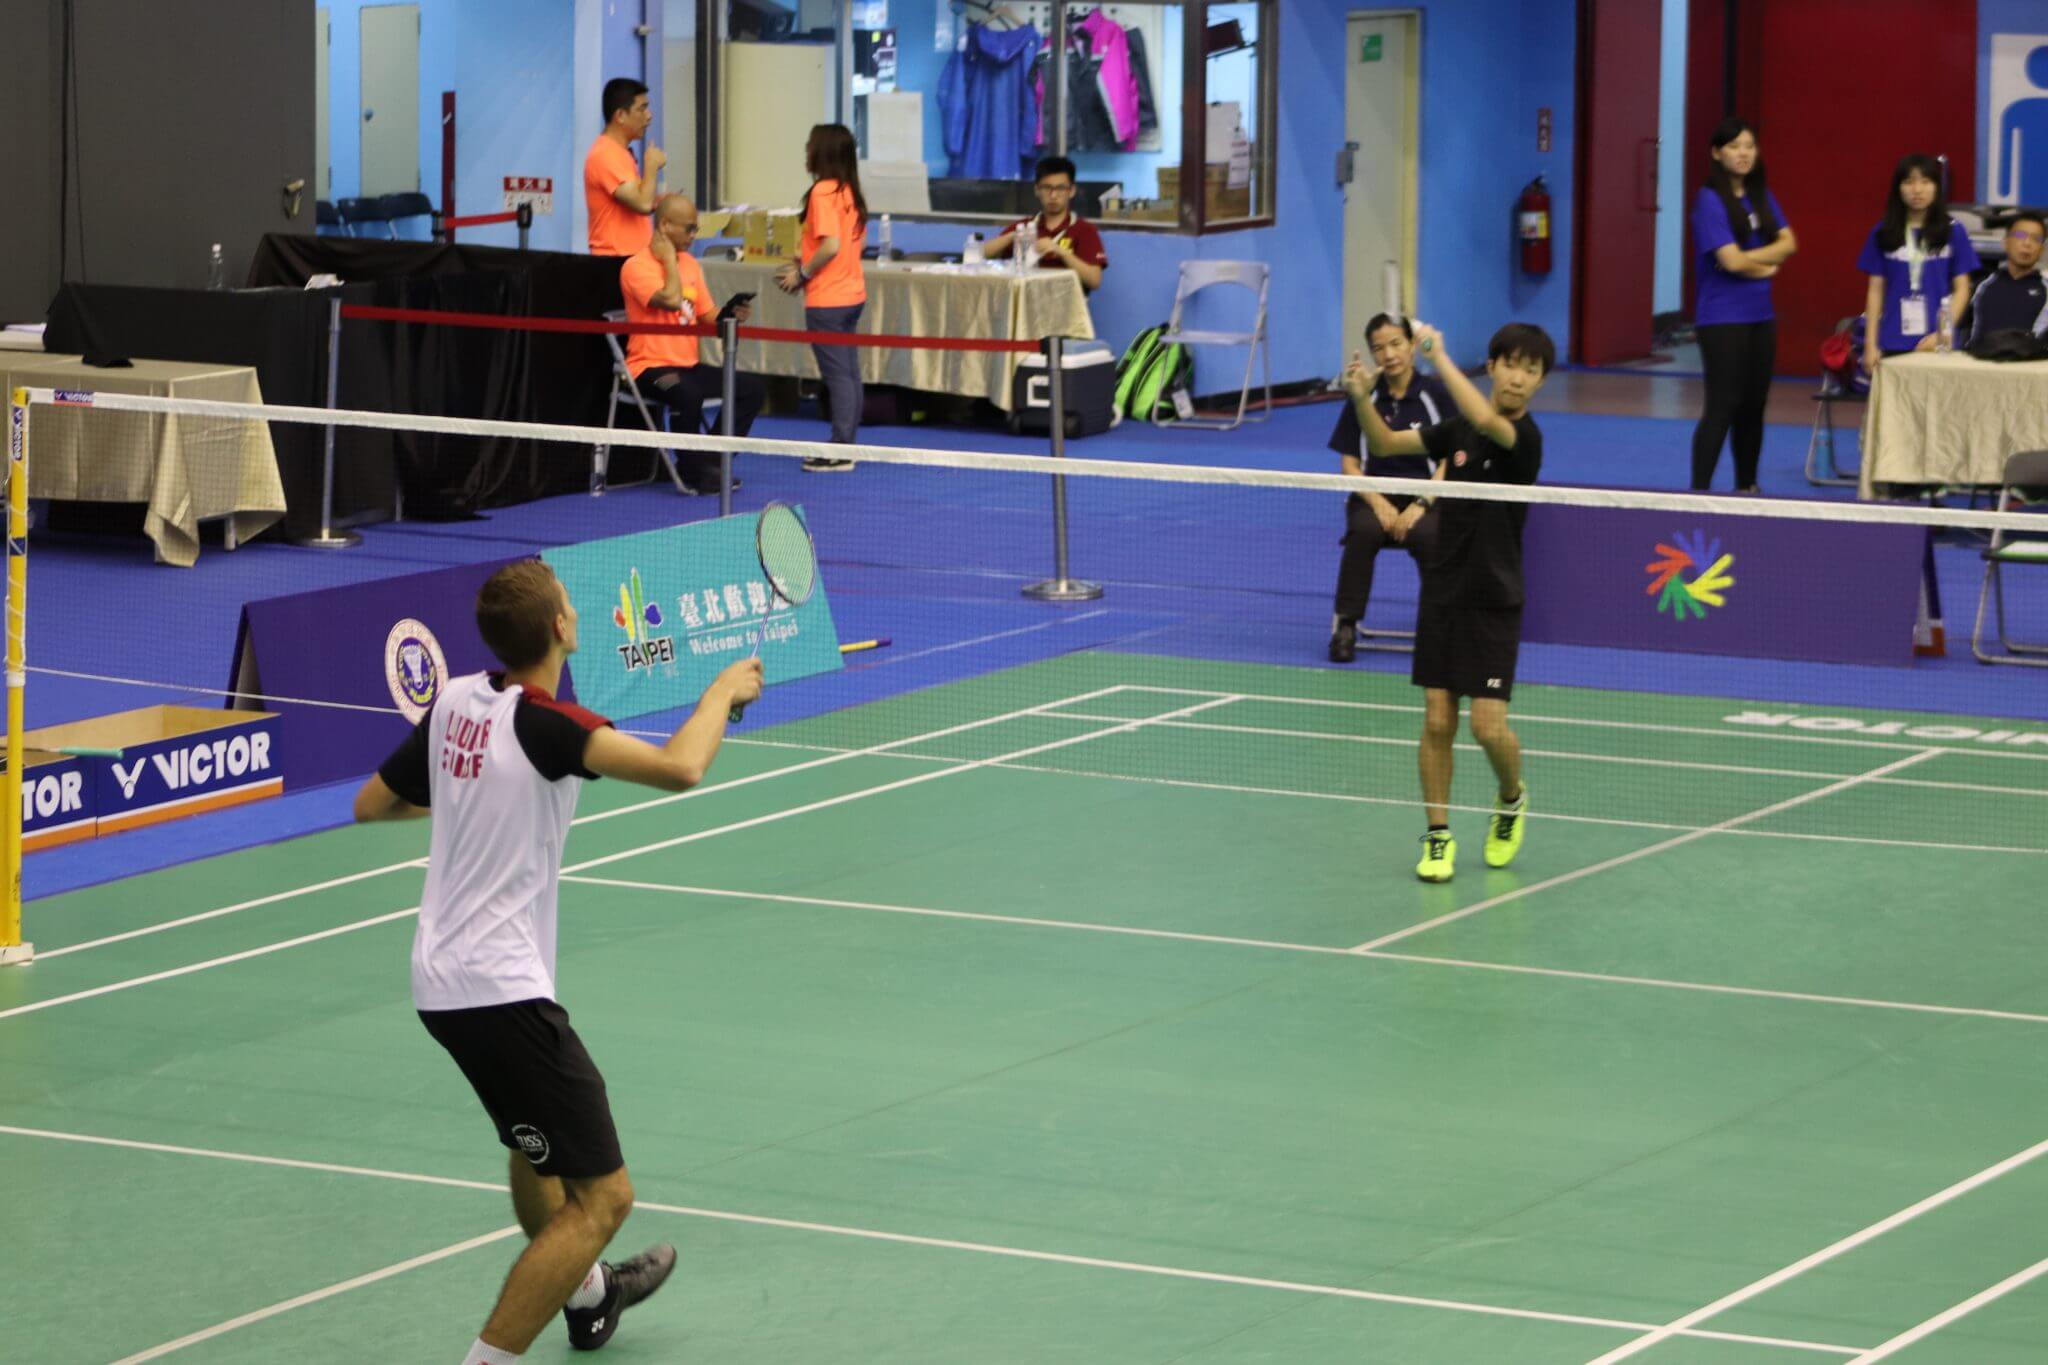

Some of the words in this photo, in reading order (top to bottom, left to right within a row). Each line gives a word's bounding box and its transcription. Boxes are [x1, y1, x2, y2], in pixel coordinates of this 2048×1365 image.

[618, 637, 675, 670] TAIPEI
[689, 634, 744, 656] Welcome
[152, 731, 271, 790] VICTOR
[22, 770, 83, 822] TOR
